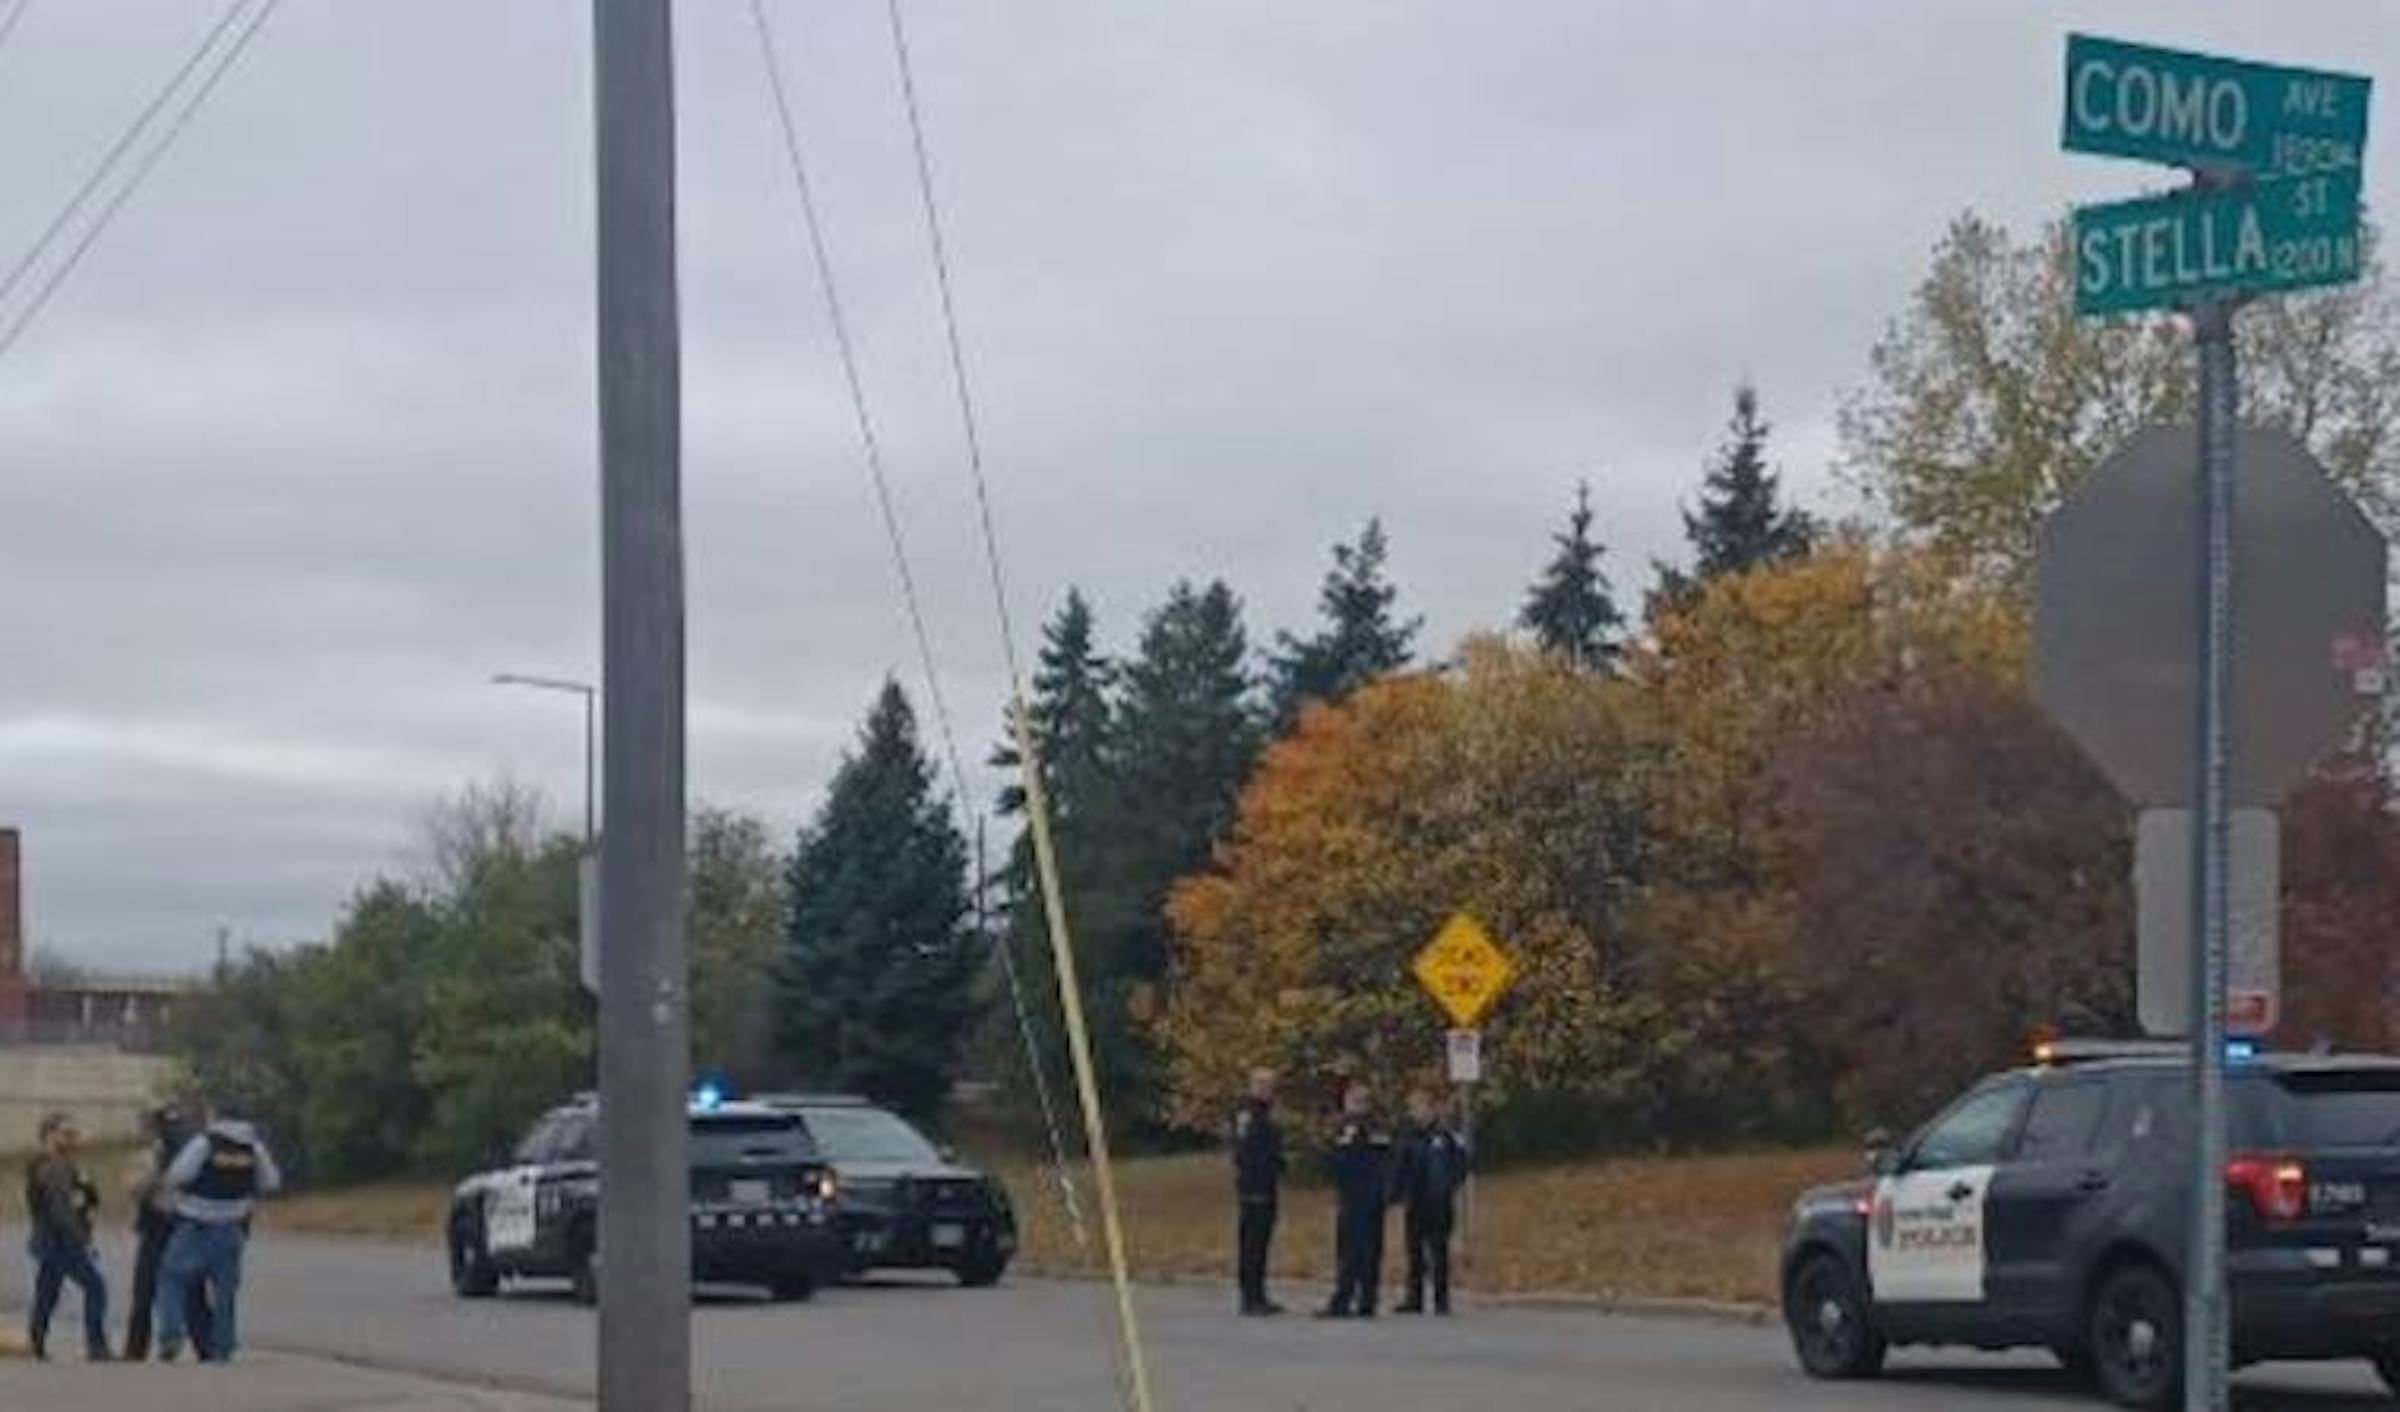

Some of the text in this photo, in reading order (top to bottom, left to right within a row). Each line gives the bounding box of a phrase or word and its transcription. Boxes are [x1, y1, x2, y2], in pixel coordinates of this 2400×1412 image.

[2073, 60, 2338, 149] COMO AVE
[2080, 176, 2328, 293] STELLA ST
[1900, 1225, 1976, 1249] POLICE
